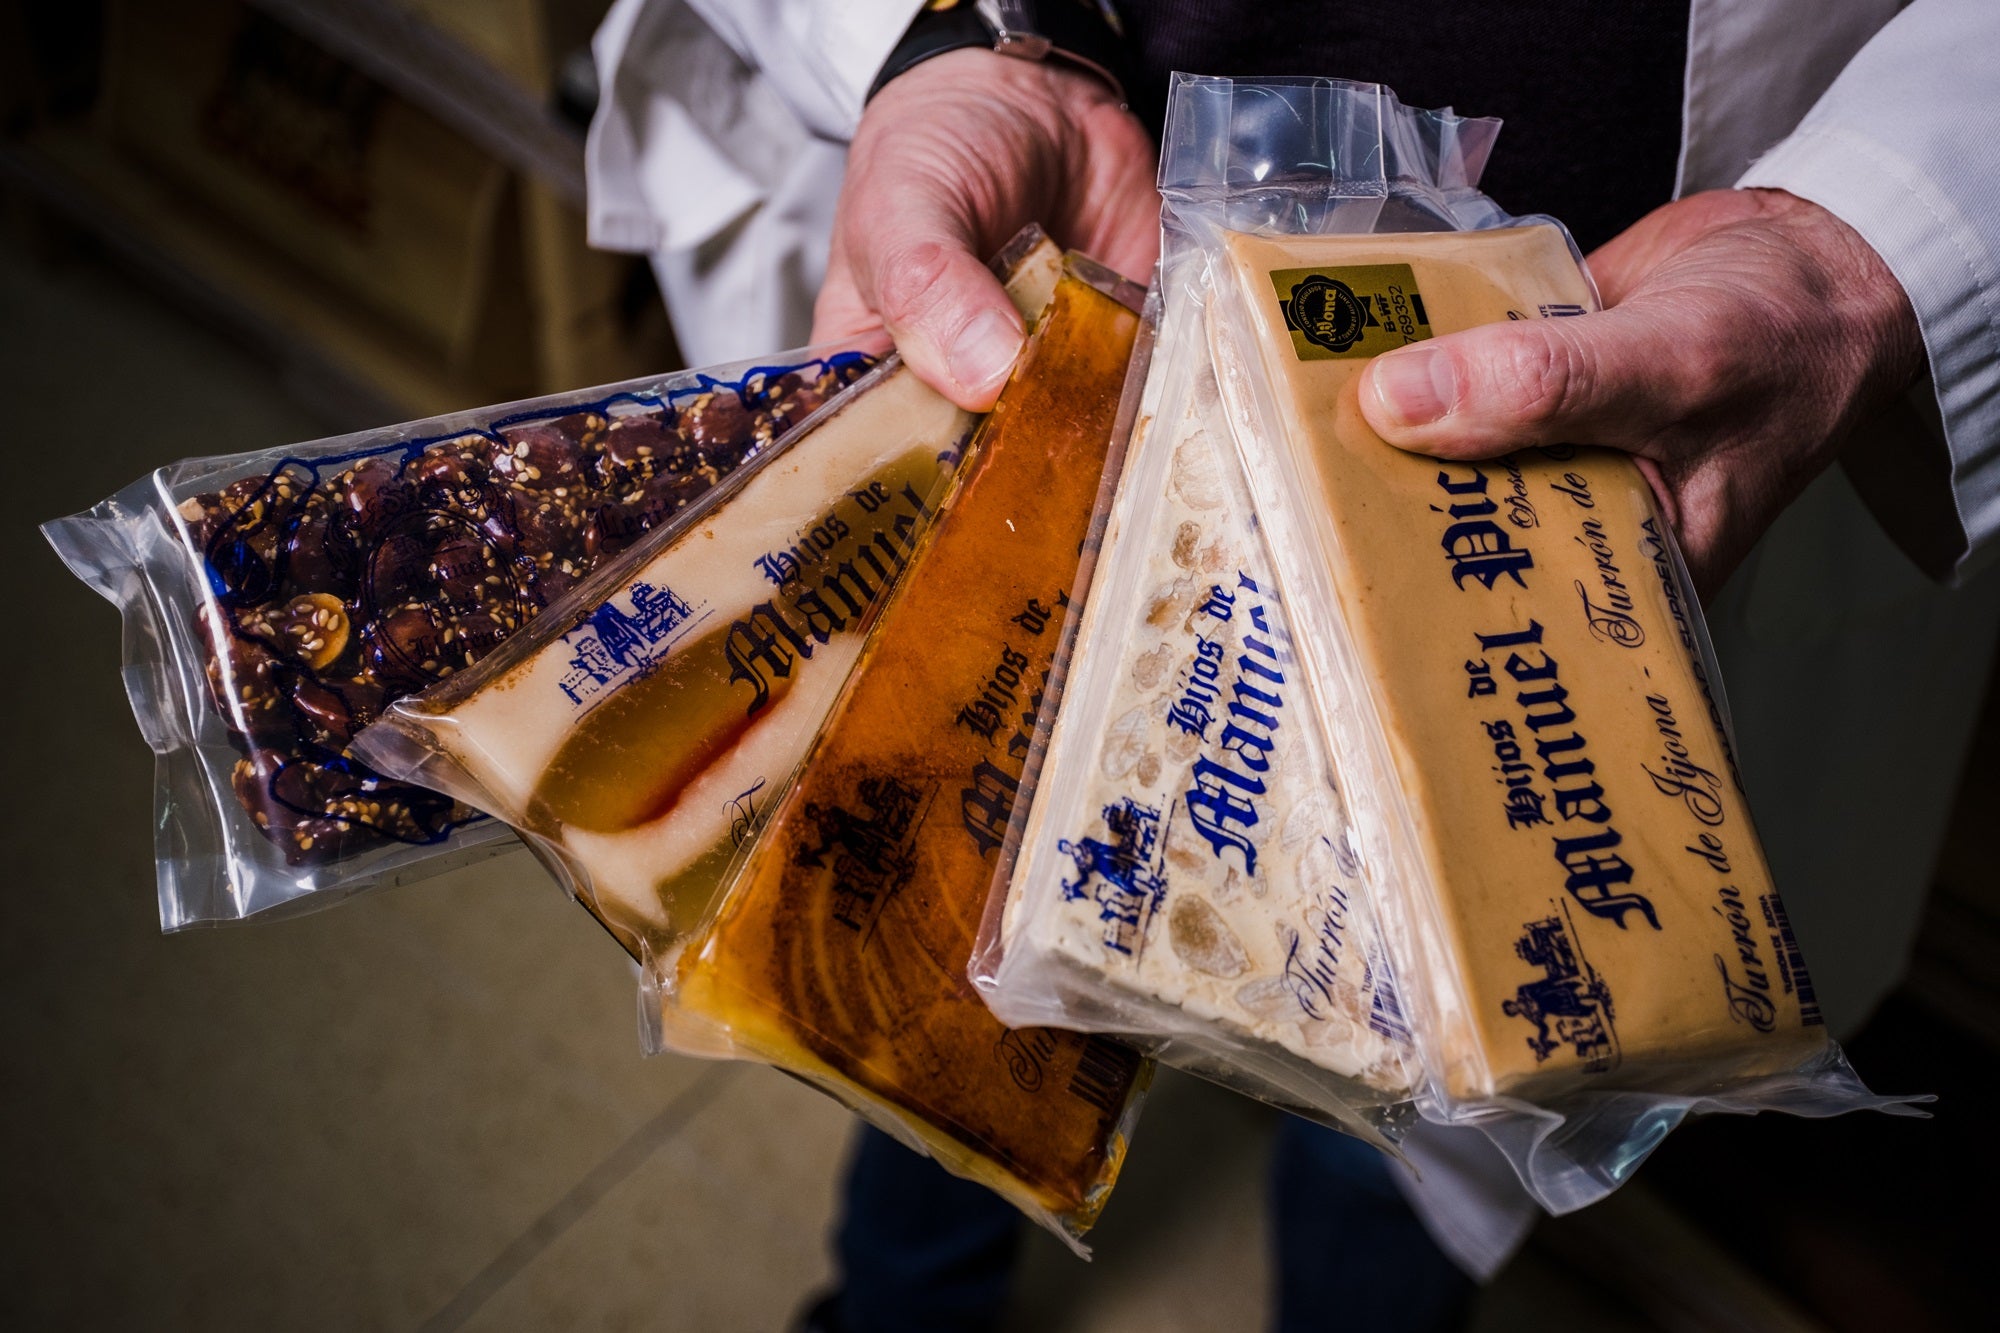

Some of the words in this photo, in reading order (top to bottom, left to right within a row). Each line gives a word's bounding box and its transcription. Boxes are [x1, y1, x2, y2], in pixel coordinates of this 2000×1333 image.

[1388, 285, 1418, 345] 769352
[753, 510, 849, 596] Hijos
[846, 480, 891, 513] de
[1430, 458, 1536, 592] Pic
[1494, 457, 1541, 528] Desd
[1550, 472, 1595, 508] de
[1573, 516, 1645, 649] Turrón
[1641, 516, 1697, 651] SUPREMA
[957, 641, 1029, 748] Hijos
[1011, 598, 1051, 635] de
[1167, 632, 1224, 743] Hijos
[1199, 584, 1237, 622] de
[1464, 658, 1497, 698] de
[1474, 618, 1663, 931] Manuel
[1480, 719, 1554, 831] Hijos
[1640, 694, 1726, 827] Jijona
[1685, 831, 1731, 875] de
[1713, 886, 1776, 1034] Turrón
